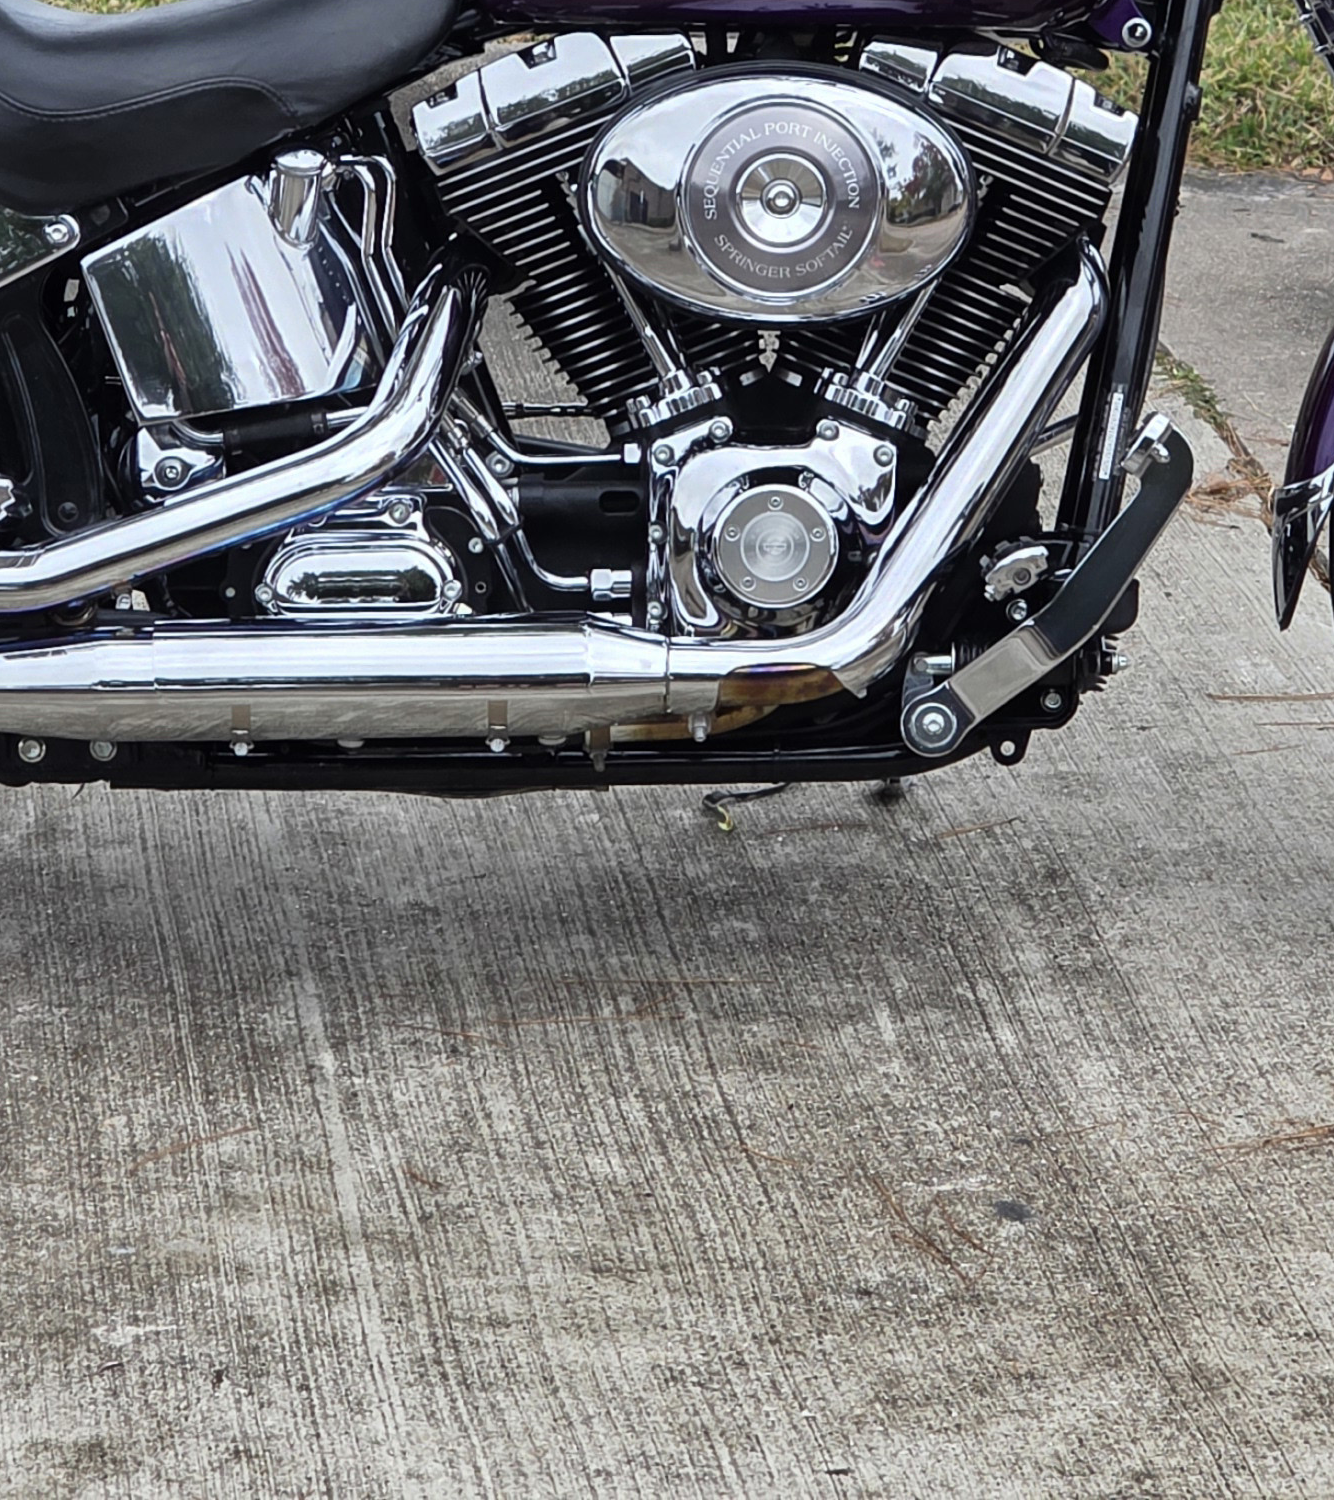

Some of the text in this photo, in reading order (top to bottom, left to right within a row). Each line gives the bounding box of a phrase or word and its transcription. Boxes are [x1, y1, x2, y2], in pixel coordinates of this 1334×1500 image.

[704, 121, 860, 220] SEQUENTIAL PORT INJECTION
[714, 234, 791, 278] SPRINGER
